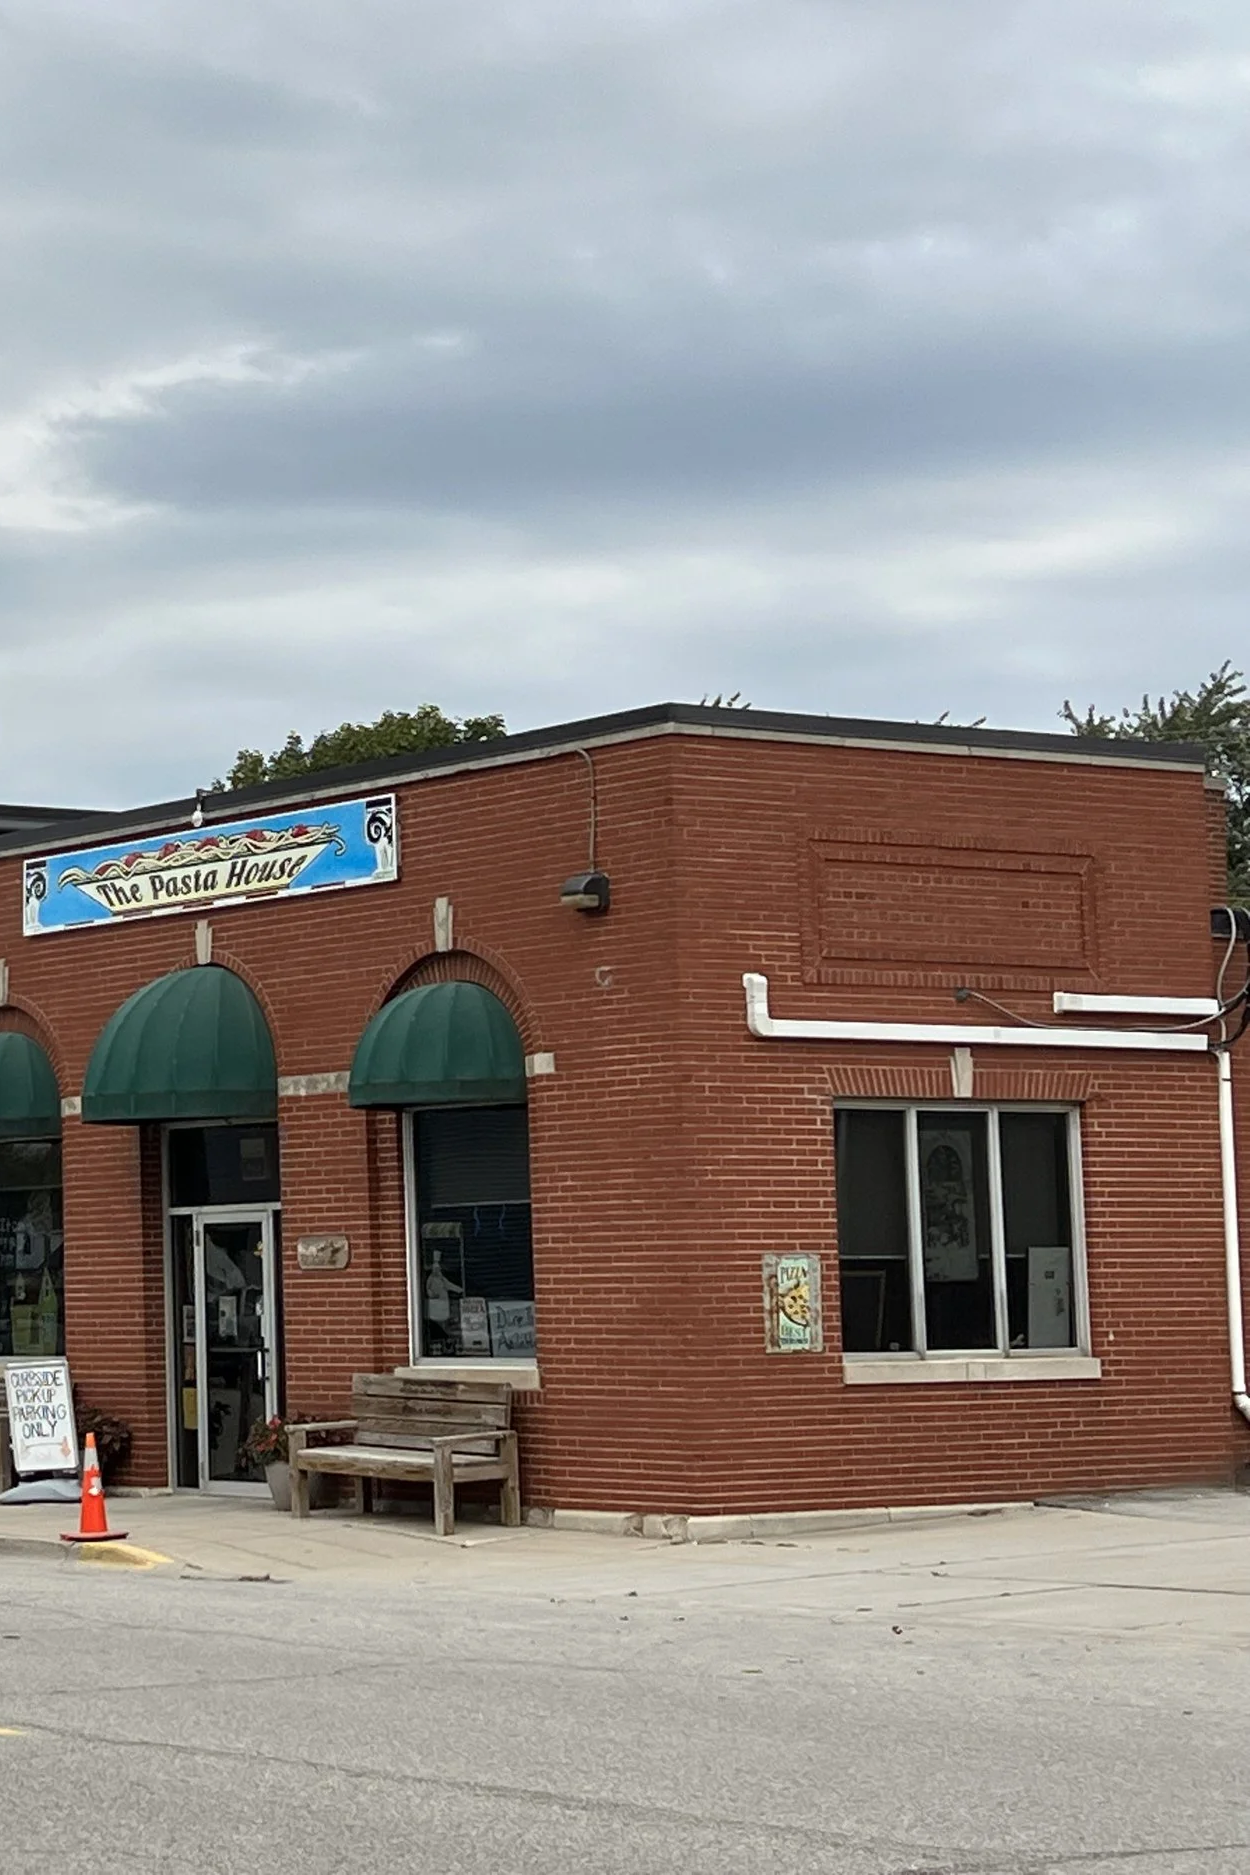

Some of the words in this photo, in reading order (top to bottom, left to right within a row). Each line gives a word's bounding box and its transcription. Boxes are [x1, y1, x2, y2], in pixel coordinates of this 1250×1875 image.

[96, 882, 142, 908] The
[150, 867, 219, 901] Pasta
[225, 854, 308, 888] House
[10, 1370, 64, 1389] CURBSIDE
[12, 1403, 67, 1423] PARKING
[22, 1420, 58, 1440] ONLY
